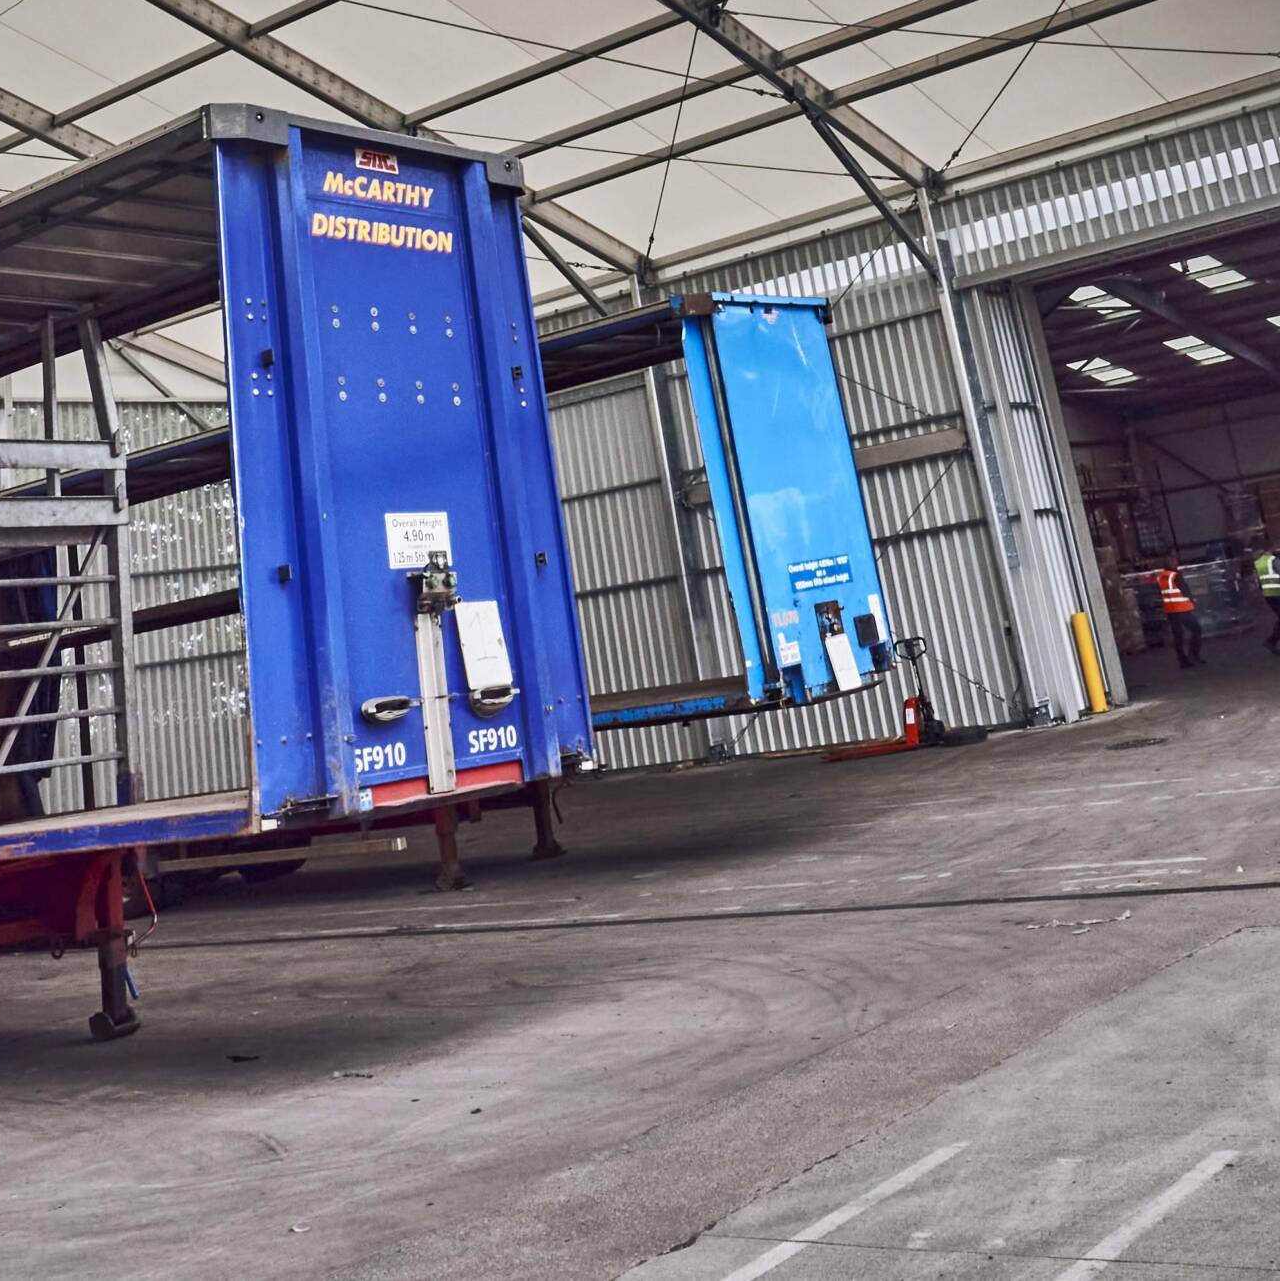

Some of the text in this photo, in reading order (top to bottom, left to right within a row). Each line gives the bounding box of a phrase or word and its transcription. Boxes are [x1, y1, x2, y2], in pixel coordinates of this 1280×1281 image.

[322, 171, 434, 208] McCARTHY
[311, 212, 453, 254] DISTRIBUTION
[392, 519, 417, 528] Overall
[468, 725, 517, 754] SF910
[353, 742, 406, 773] SF910
